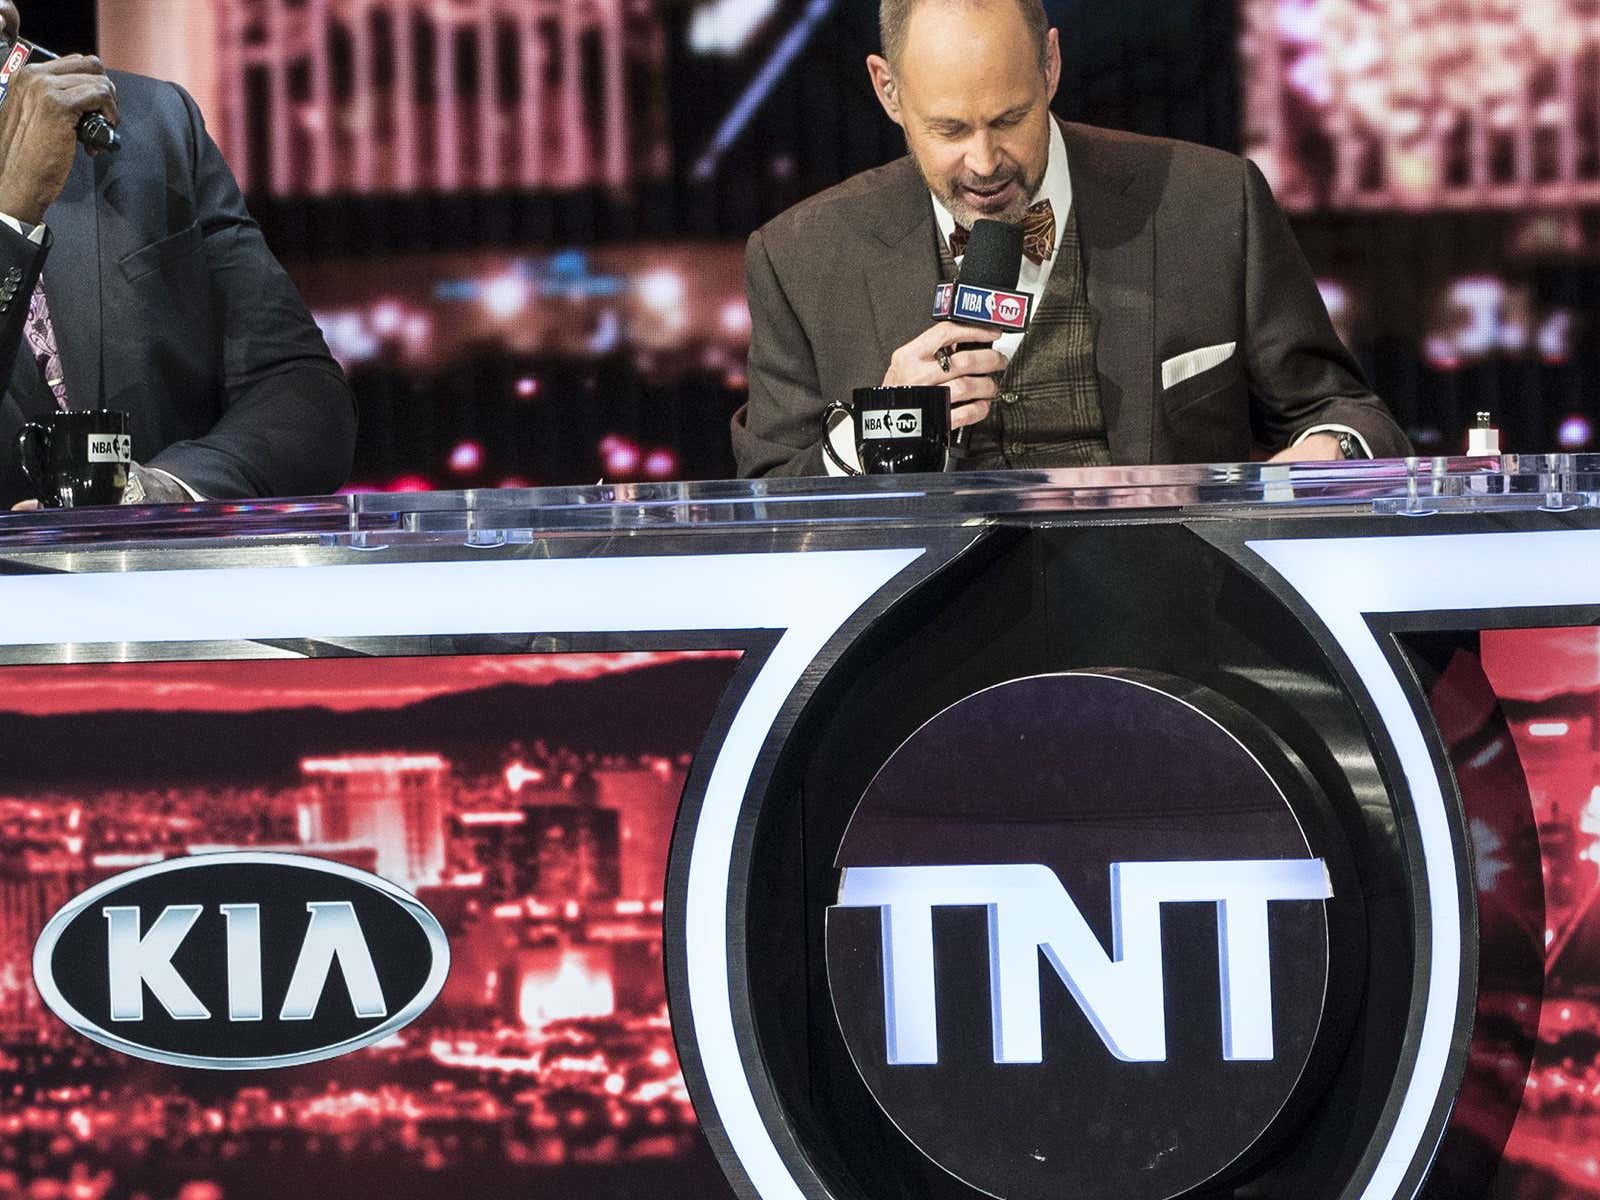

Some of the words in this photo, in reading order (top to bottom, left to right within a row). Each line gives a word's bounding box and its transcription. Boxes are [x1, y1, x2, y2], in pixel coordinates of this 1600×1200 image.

[961, 291, 983, 313] NBA
[999, 304, 1020, 317] TNT
[864, 418, 882, 431] NBA
[895, 418, 918, 431] TNT
[92, 441, 113, 454] NBA
[102, 900, 388, 1022] KIA
[836, 857, 1335, 1065] TNT
